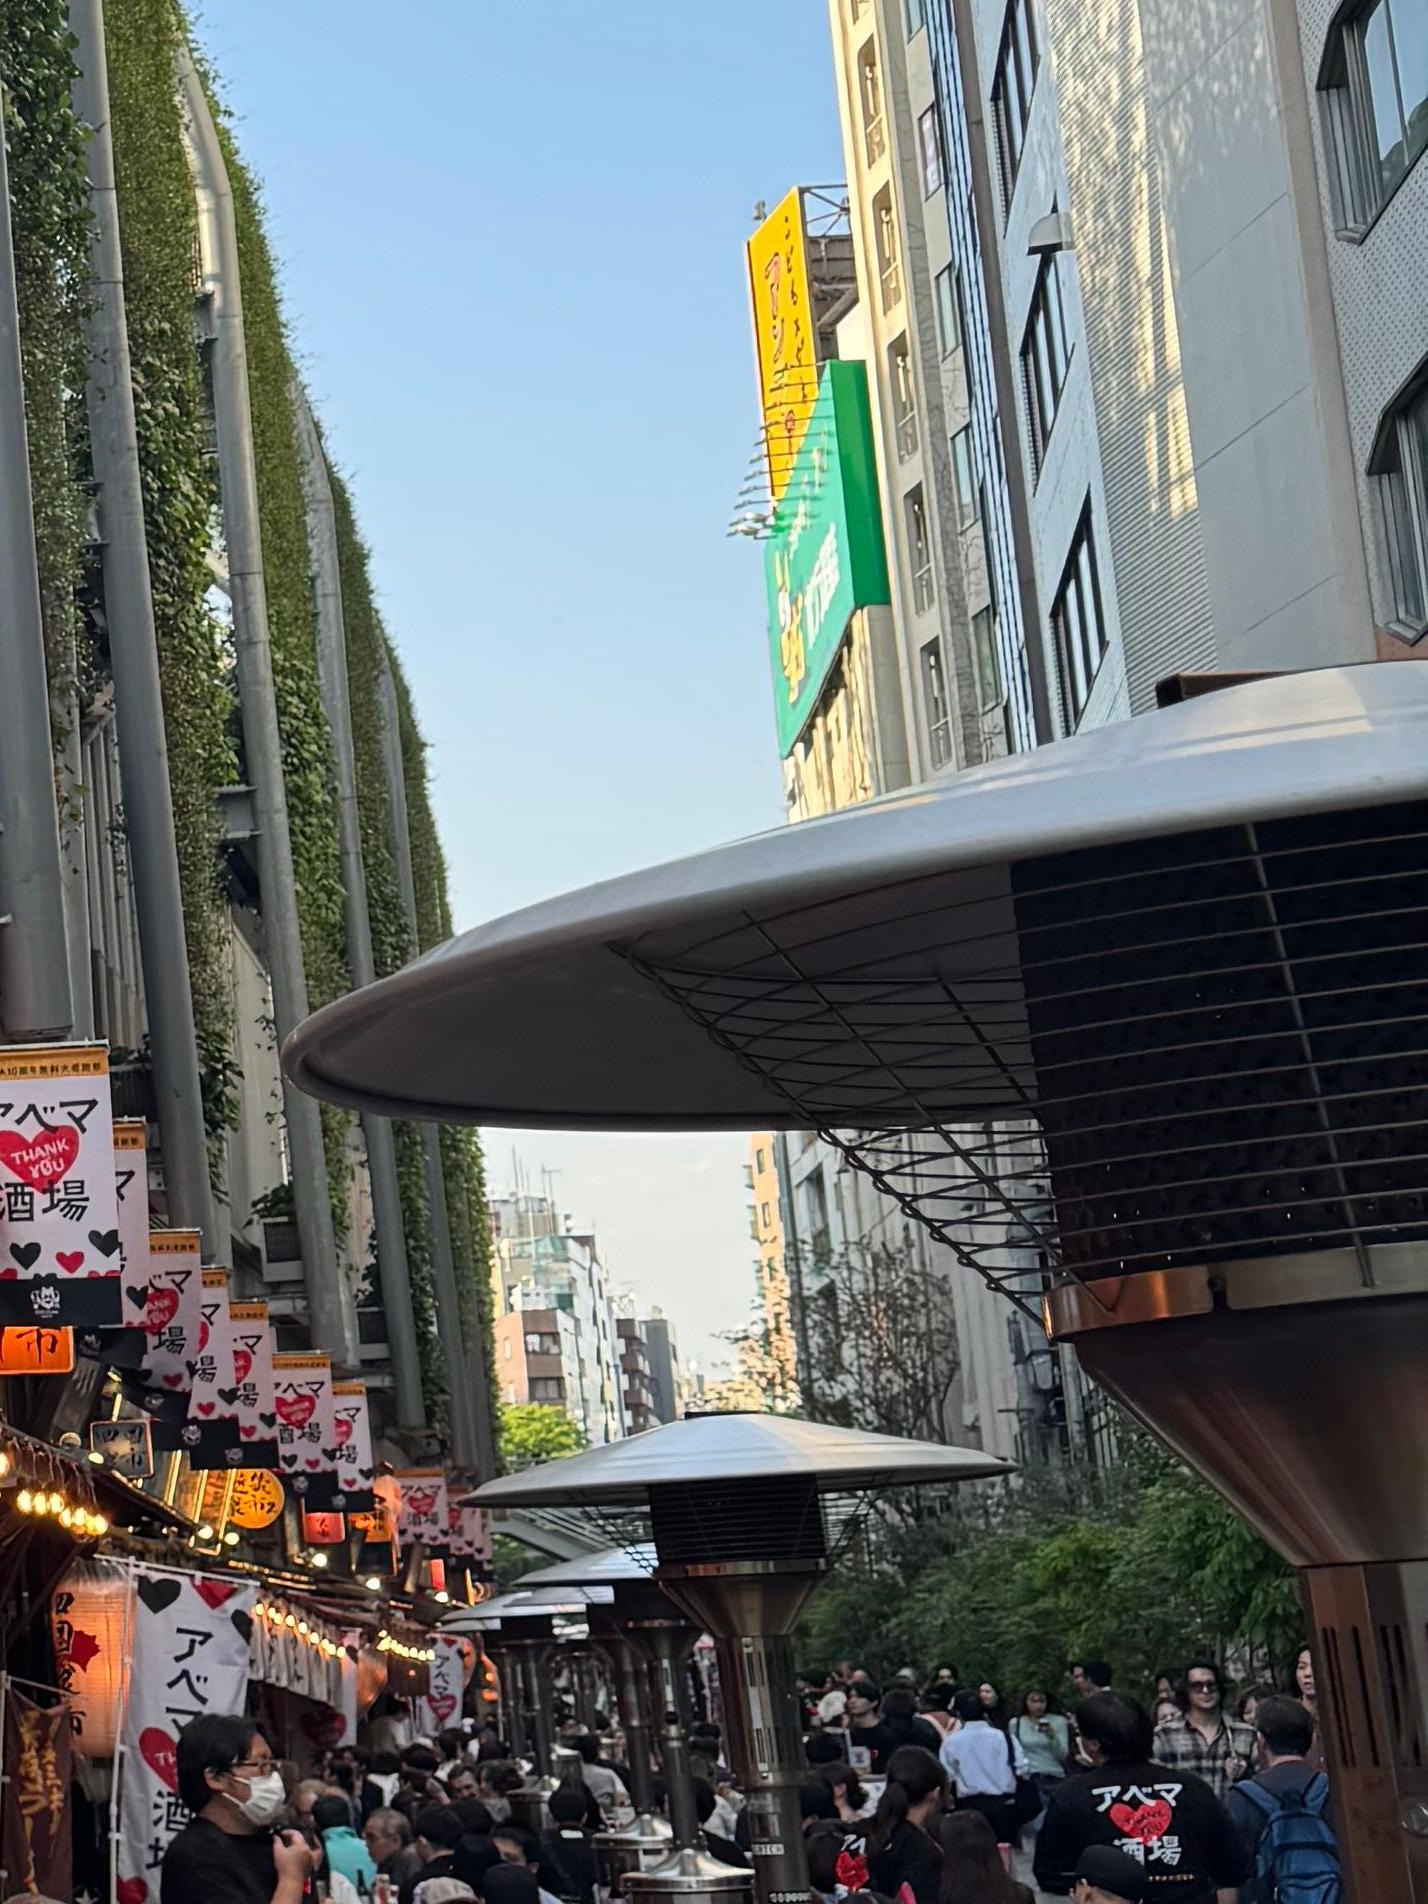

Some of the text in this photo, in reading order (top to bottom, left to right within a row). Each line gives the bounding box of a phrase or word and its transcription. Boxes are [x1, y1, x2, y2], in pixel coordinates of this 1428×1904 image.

[10, 1138, 70, 1163] THANK
[151, 1325, 187, 1355] 場
[1090, 1782, 1184, 1812] アベマ
